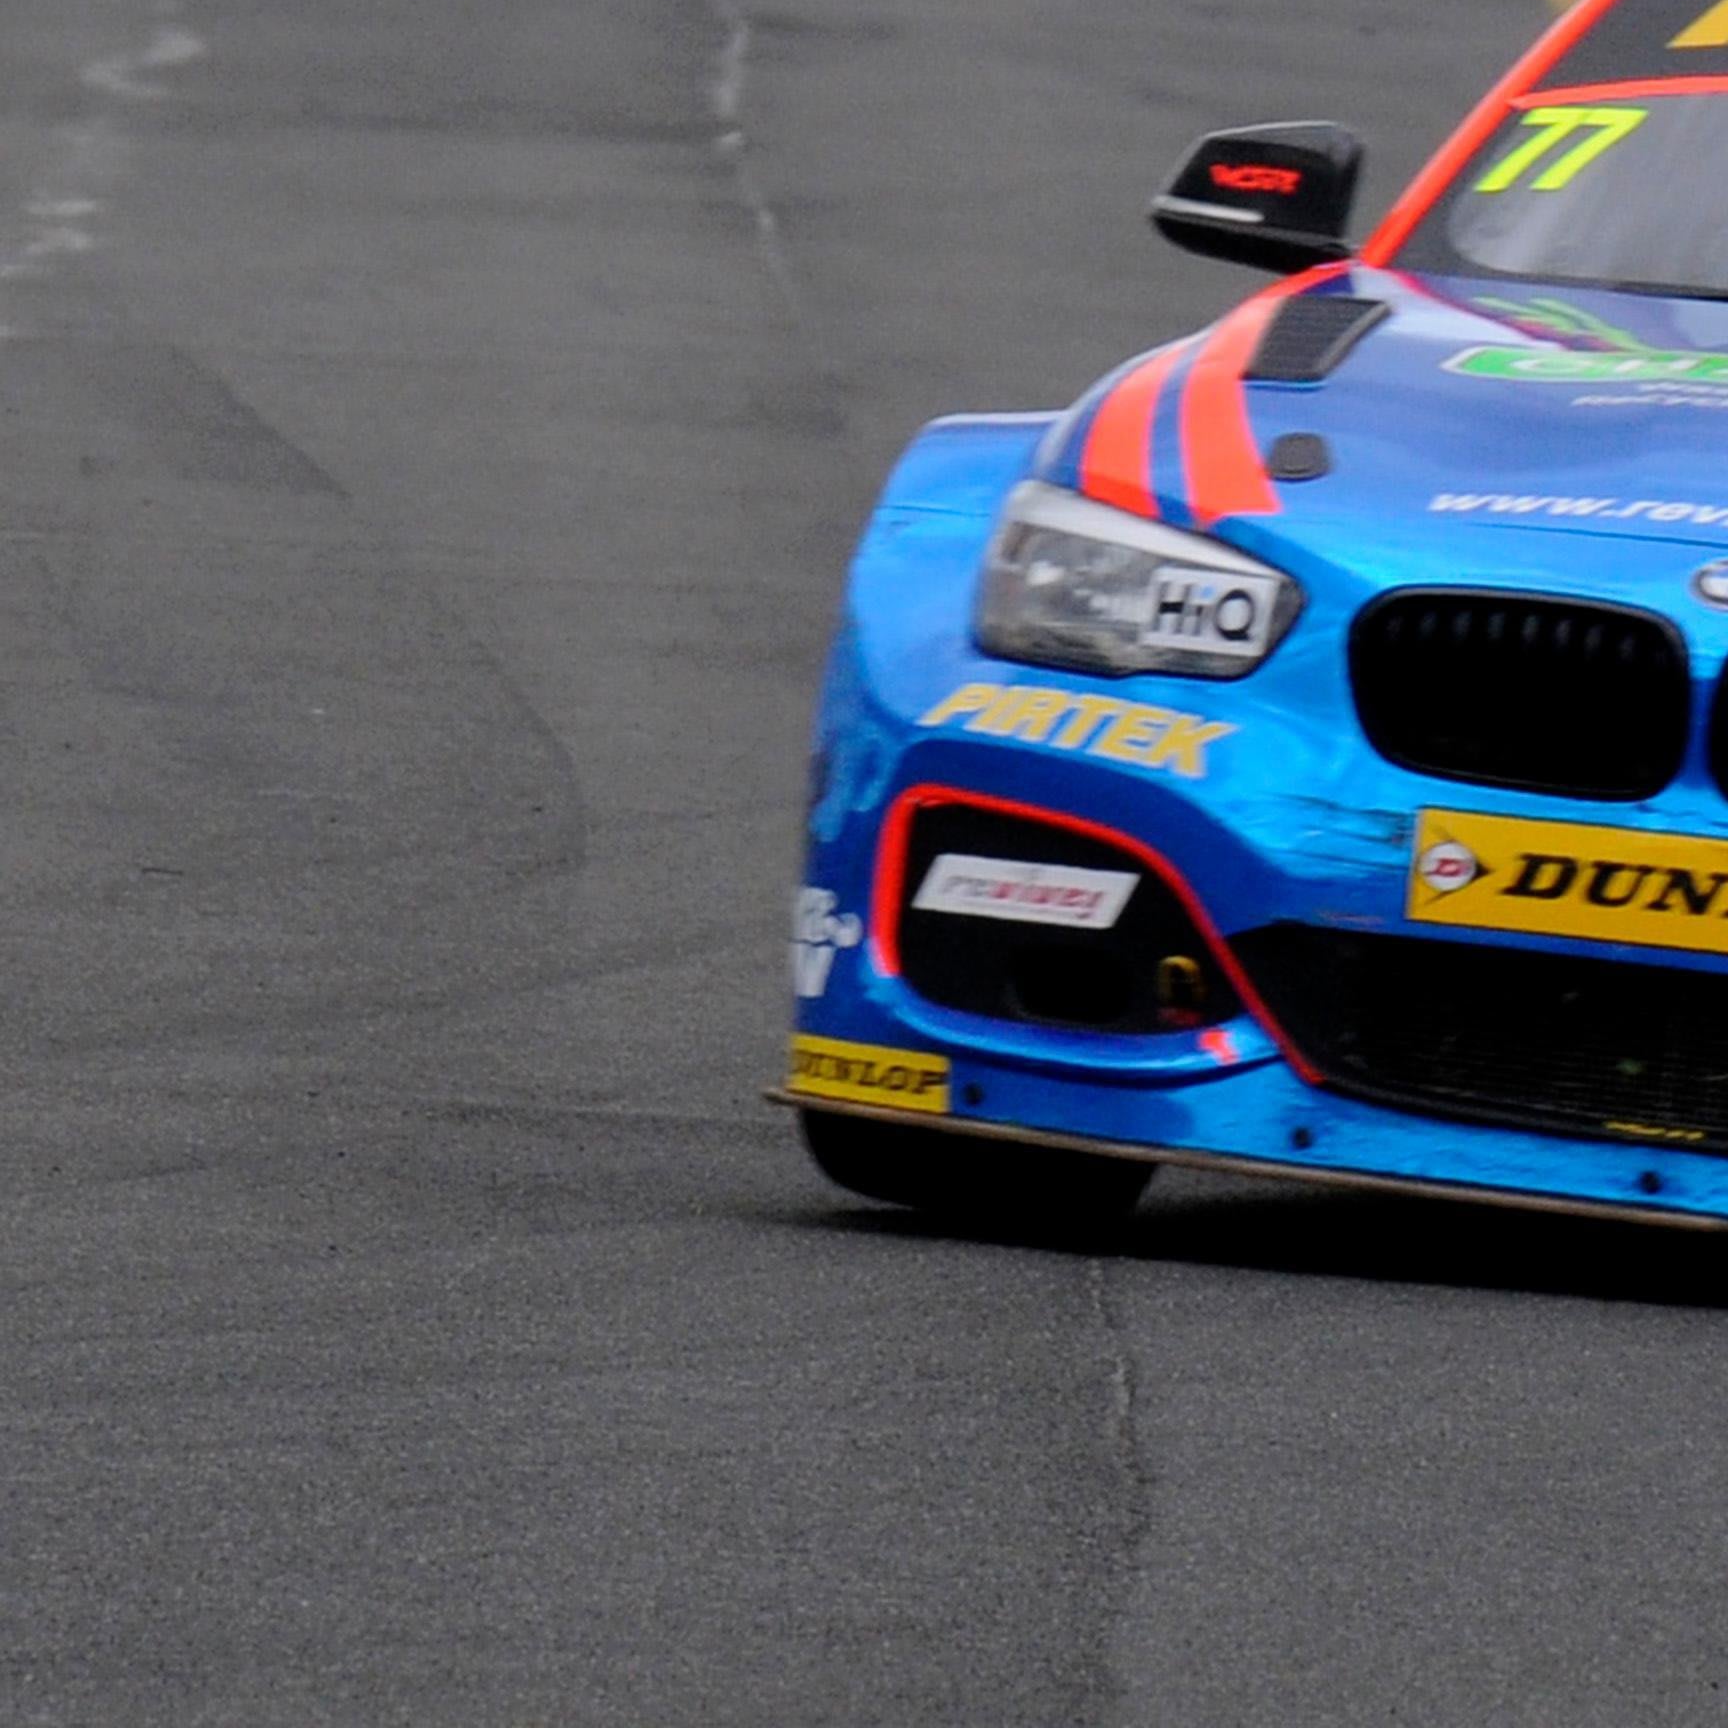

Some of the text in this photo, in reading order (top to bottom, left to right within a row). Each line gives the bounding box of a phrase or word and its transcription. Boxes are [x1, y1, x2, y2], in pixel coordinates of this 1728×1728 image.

[1474, 105, 1650, 193] 77
[1150, 580, 1258, 644] HiQ
[915, 682, 1238, 778] PIRTEK
